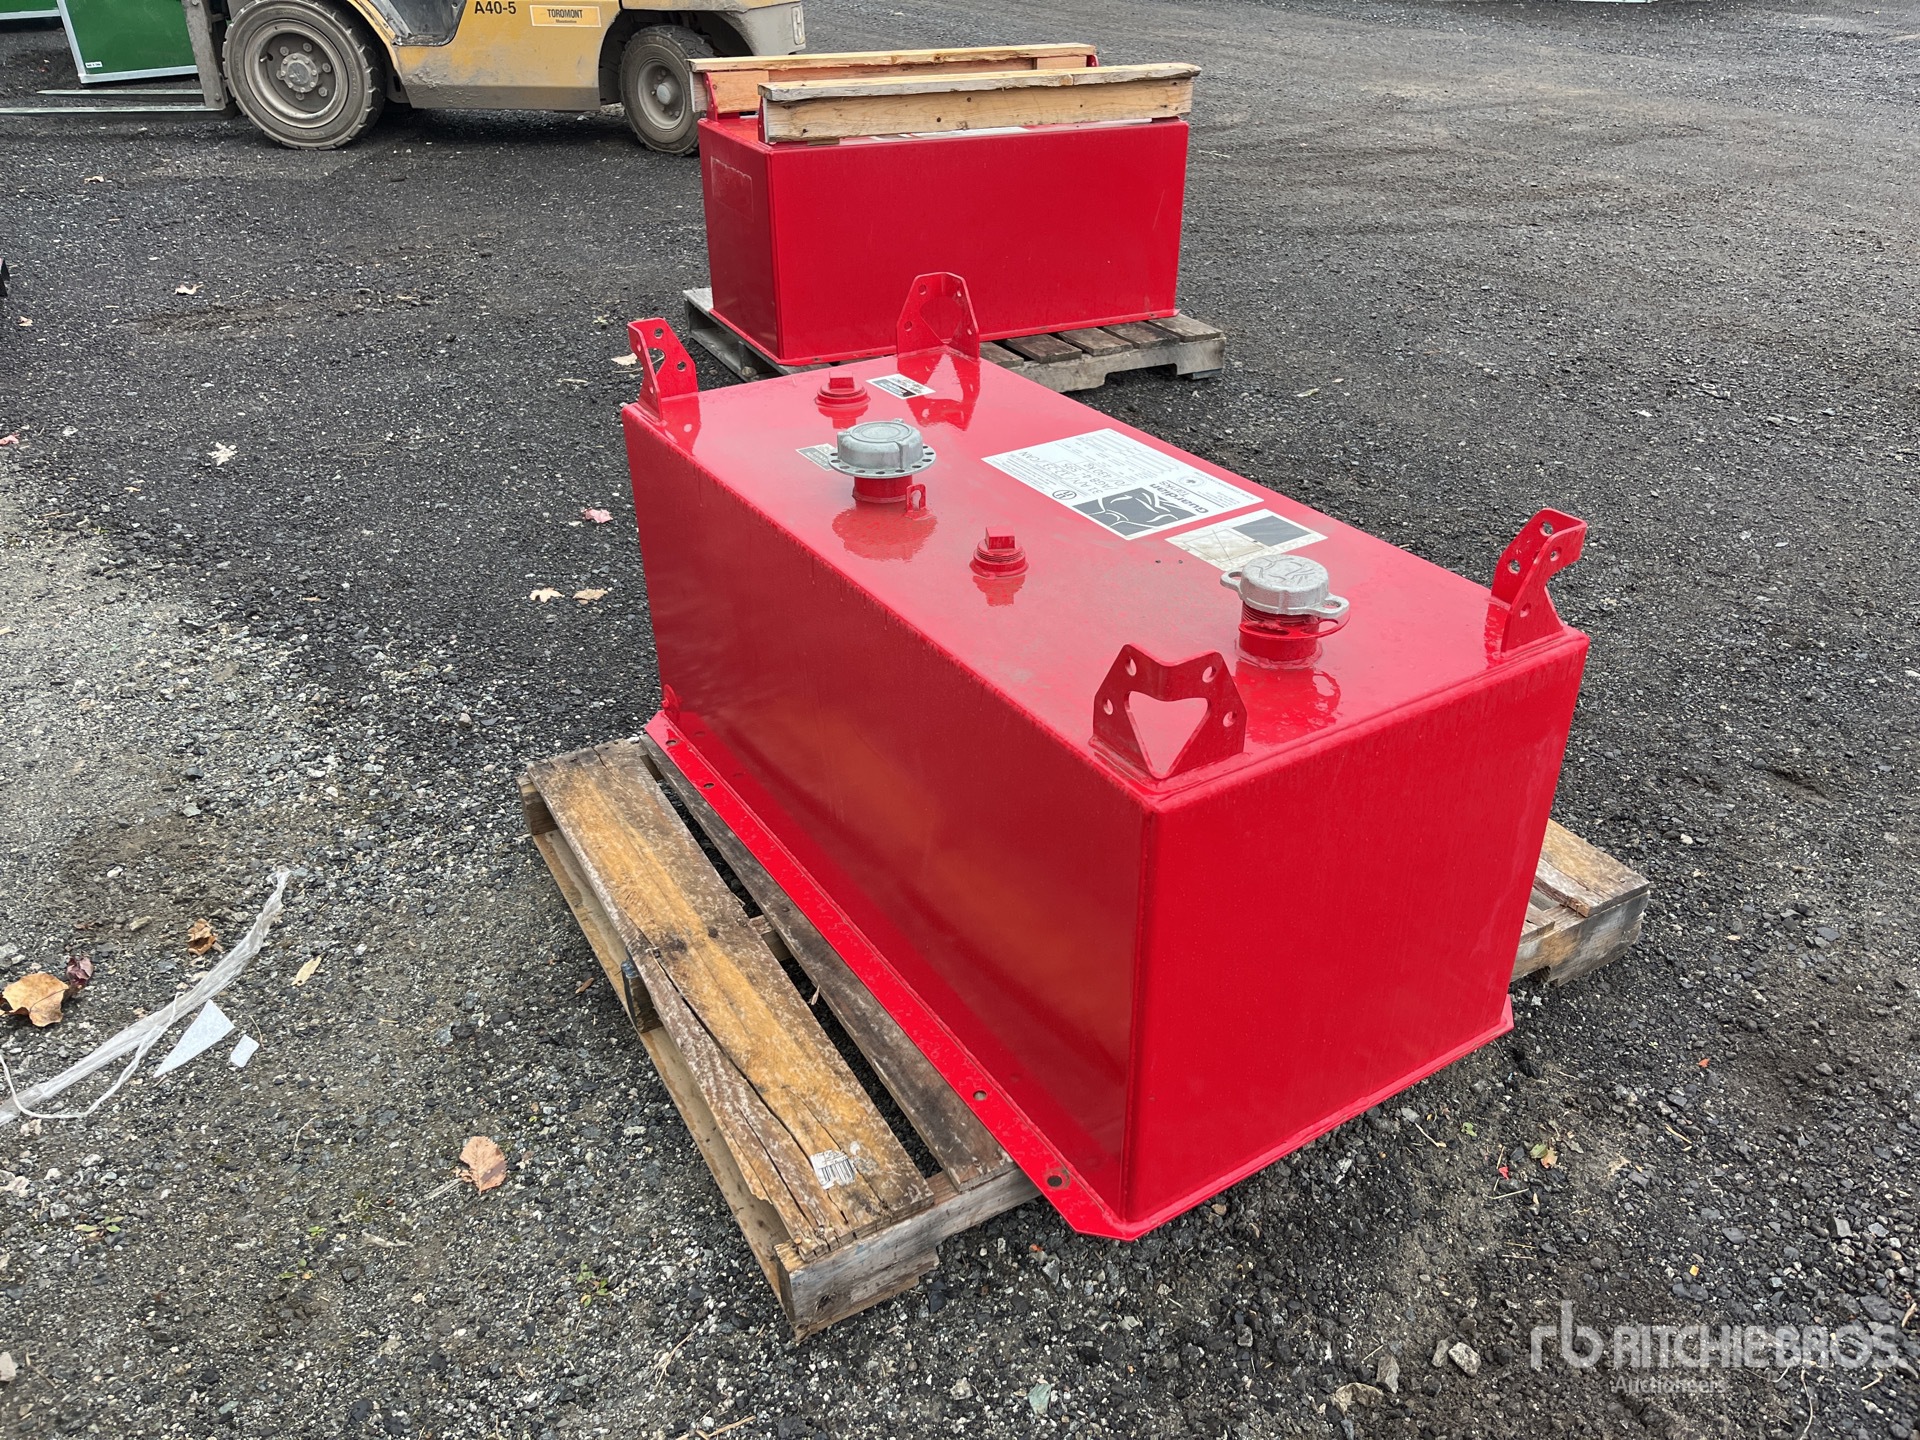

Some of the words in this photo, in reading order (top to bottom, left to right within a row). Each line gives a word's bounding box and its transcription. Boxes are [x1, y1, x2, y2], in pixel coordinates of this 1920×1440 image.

[474, 1, 517, 14] A40-5
[547, 9, 583, 18] TOROMONT
[1158, 480, 1189, 496] Tanks
[1149, 483, 1208, 513] Guardian
